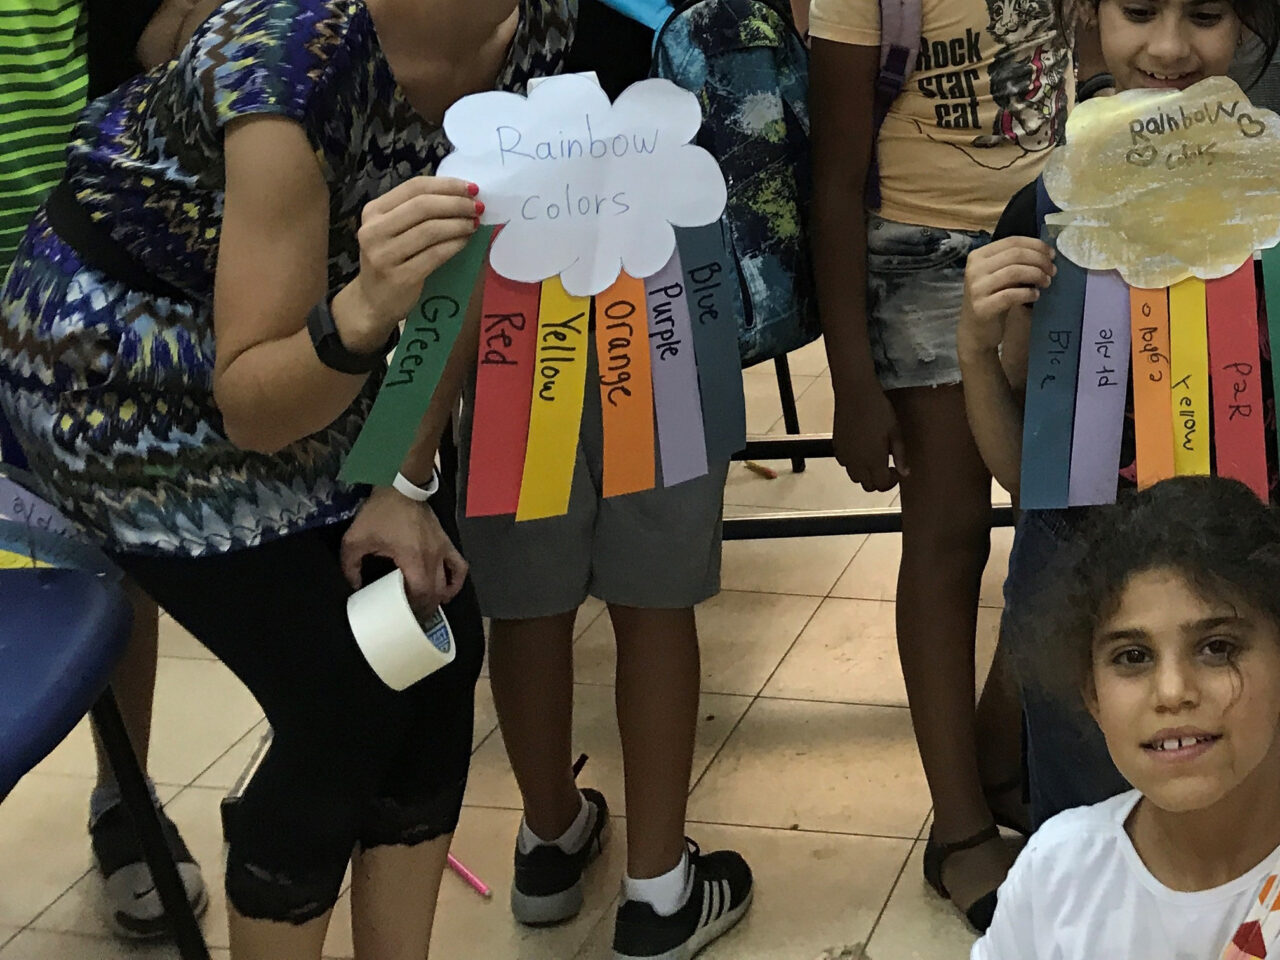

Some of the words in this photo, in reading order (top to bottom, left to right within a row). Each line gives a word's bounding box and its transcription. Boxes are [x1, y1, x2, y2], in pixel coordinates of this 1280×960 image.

[495, 113, 660, 166] Rainbow
[646, 281, 684, 362] Purple
[686, 261, 724, 326] Blue
[384, 294, 461, 389] Green
[480, 310, 528, 367] Red
[537, 311, 586, 403] Yellow
[599, 298, 637, 408] Orange
